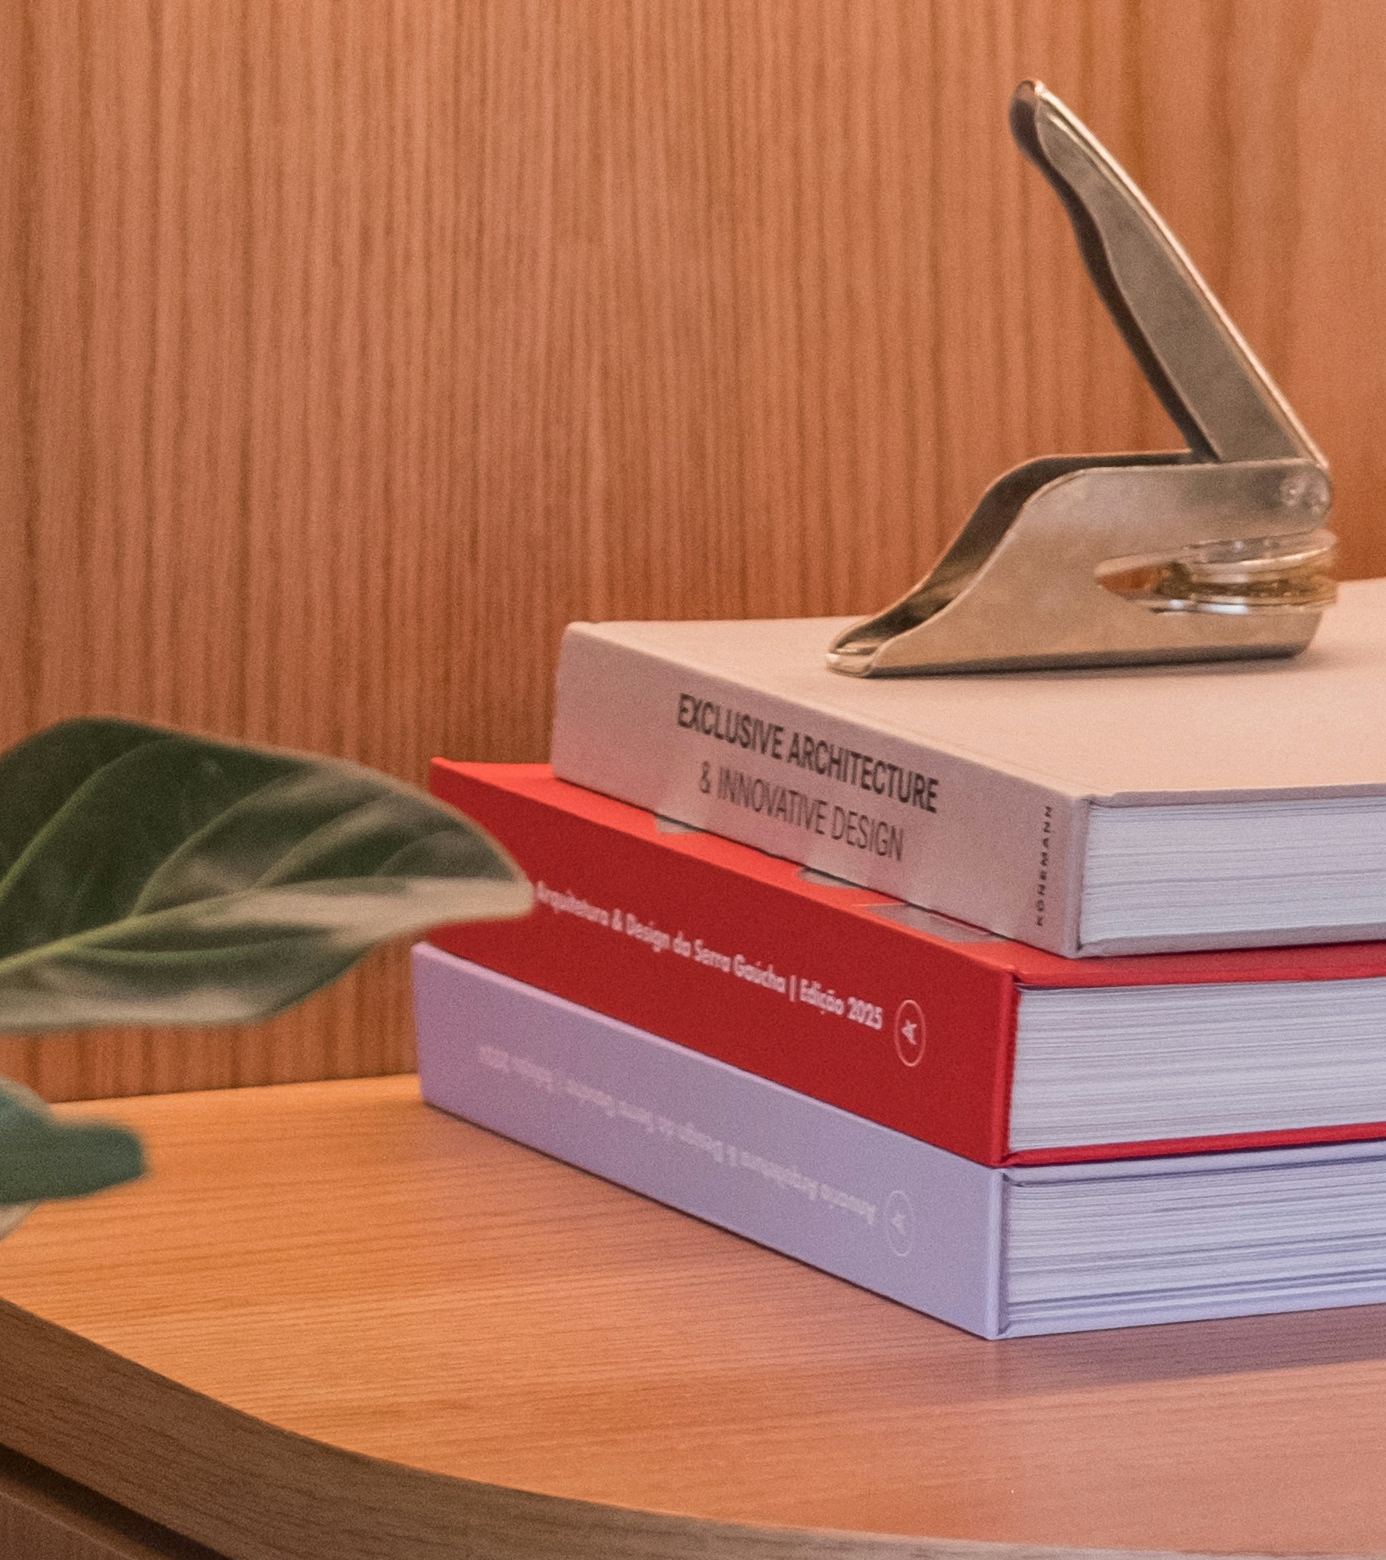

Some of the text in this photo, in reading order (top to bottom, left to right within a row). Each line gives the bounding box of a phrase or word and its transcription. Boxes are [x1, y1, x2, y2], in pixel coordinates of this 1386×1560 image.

[677, 692, 939, 814] EXCLUSIVE ARCHITECTURE
[699, 760, 904, 862] & INNOVATIVE DESIGN
[625, 913, 670, 953] Design
